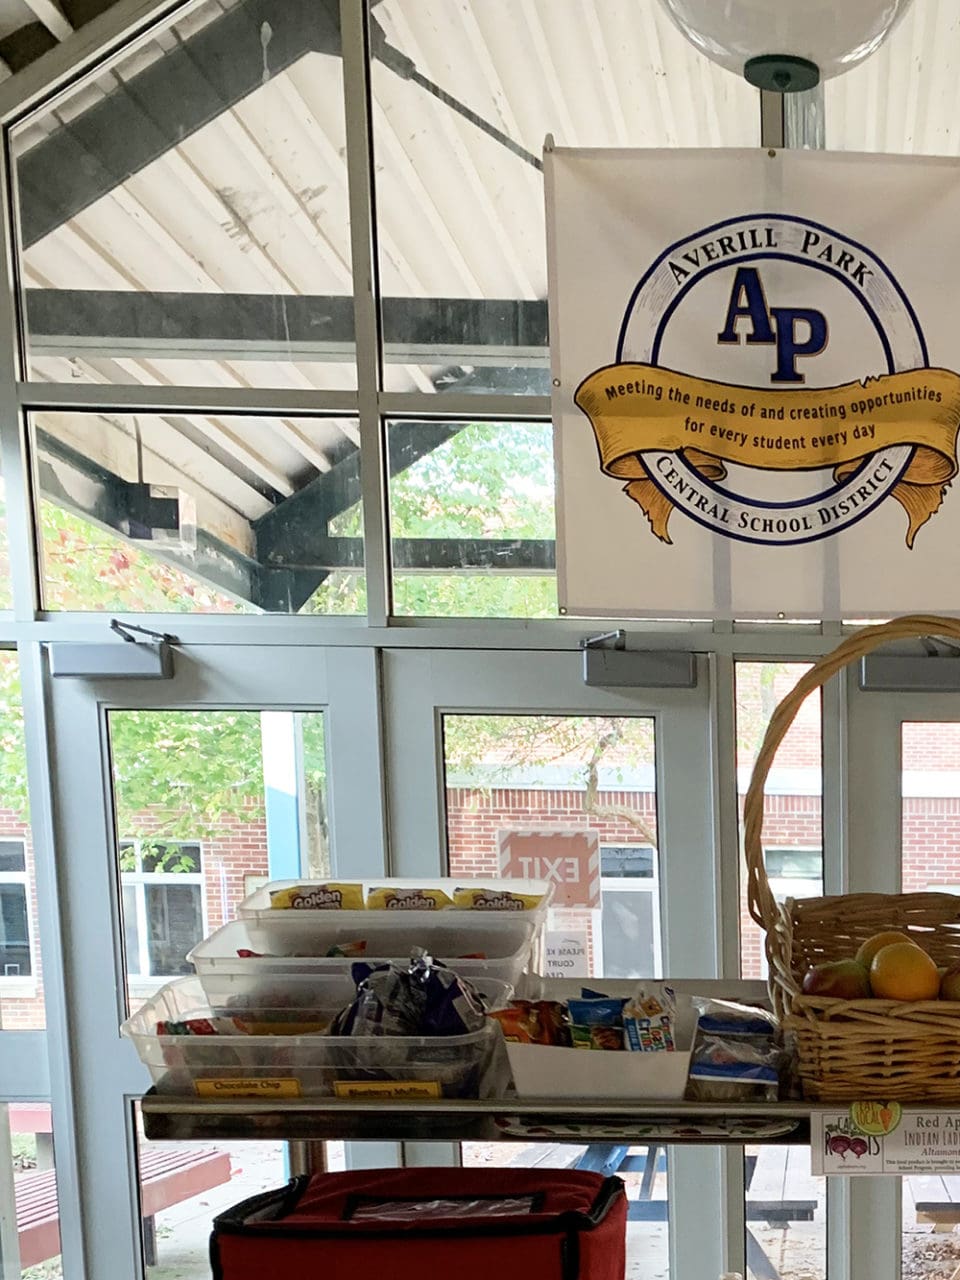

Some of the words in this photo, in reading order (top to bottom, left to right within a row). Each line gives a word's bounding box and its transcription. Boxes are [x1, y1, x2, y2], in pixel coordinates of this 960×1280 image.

[668, 228, 777, 285] AVERILL
[801, 230, 874, 287] PARK
[605, 380, 663, 401] Meeting
[669, 386, 691, 405] the
[696, 392, 736, 415] needs
[741, 402, 756, 419] of
[761, 405, 786, 420] and
[789, 403, 847, 421] creating
[851, 384, 943, 417] opportunities
[684, 417, 705, 434] for
[710, 425, 749, 447] every
[753, 431, 806, 450] student
[811, 431, 848, 449] every
[852, 423, 876, 442] day
[656, 455, 730, 524] CENTRAL
[737, 511, 812, 534] SCHOOL
[820, 457, 895, 526] DISTRICT
[293, 890, 341, 909] Golden
[904, 1130, 938, 1146] INDIAN
[916, 1117, 939, 1128] Red
